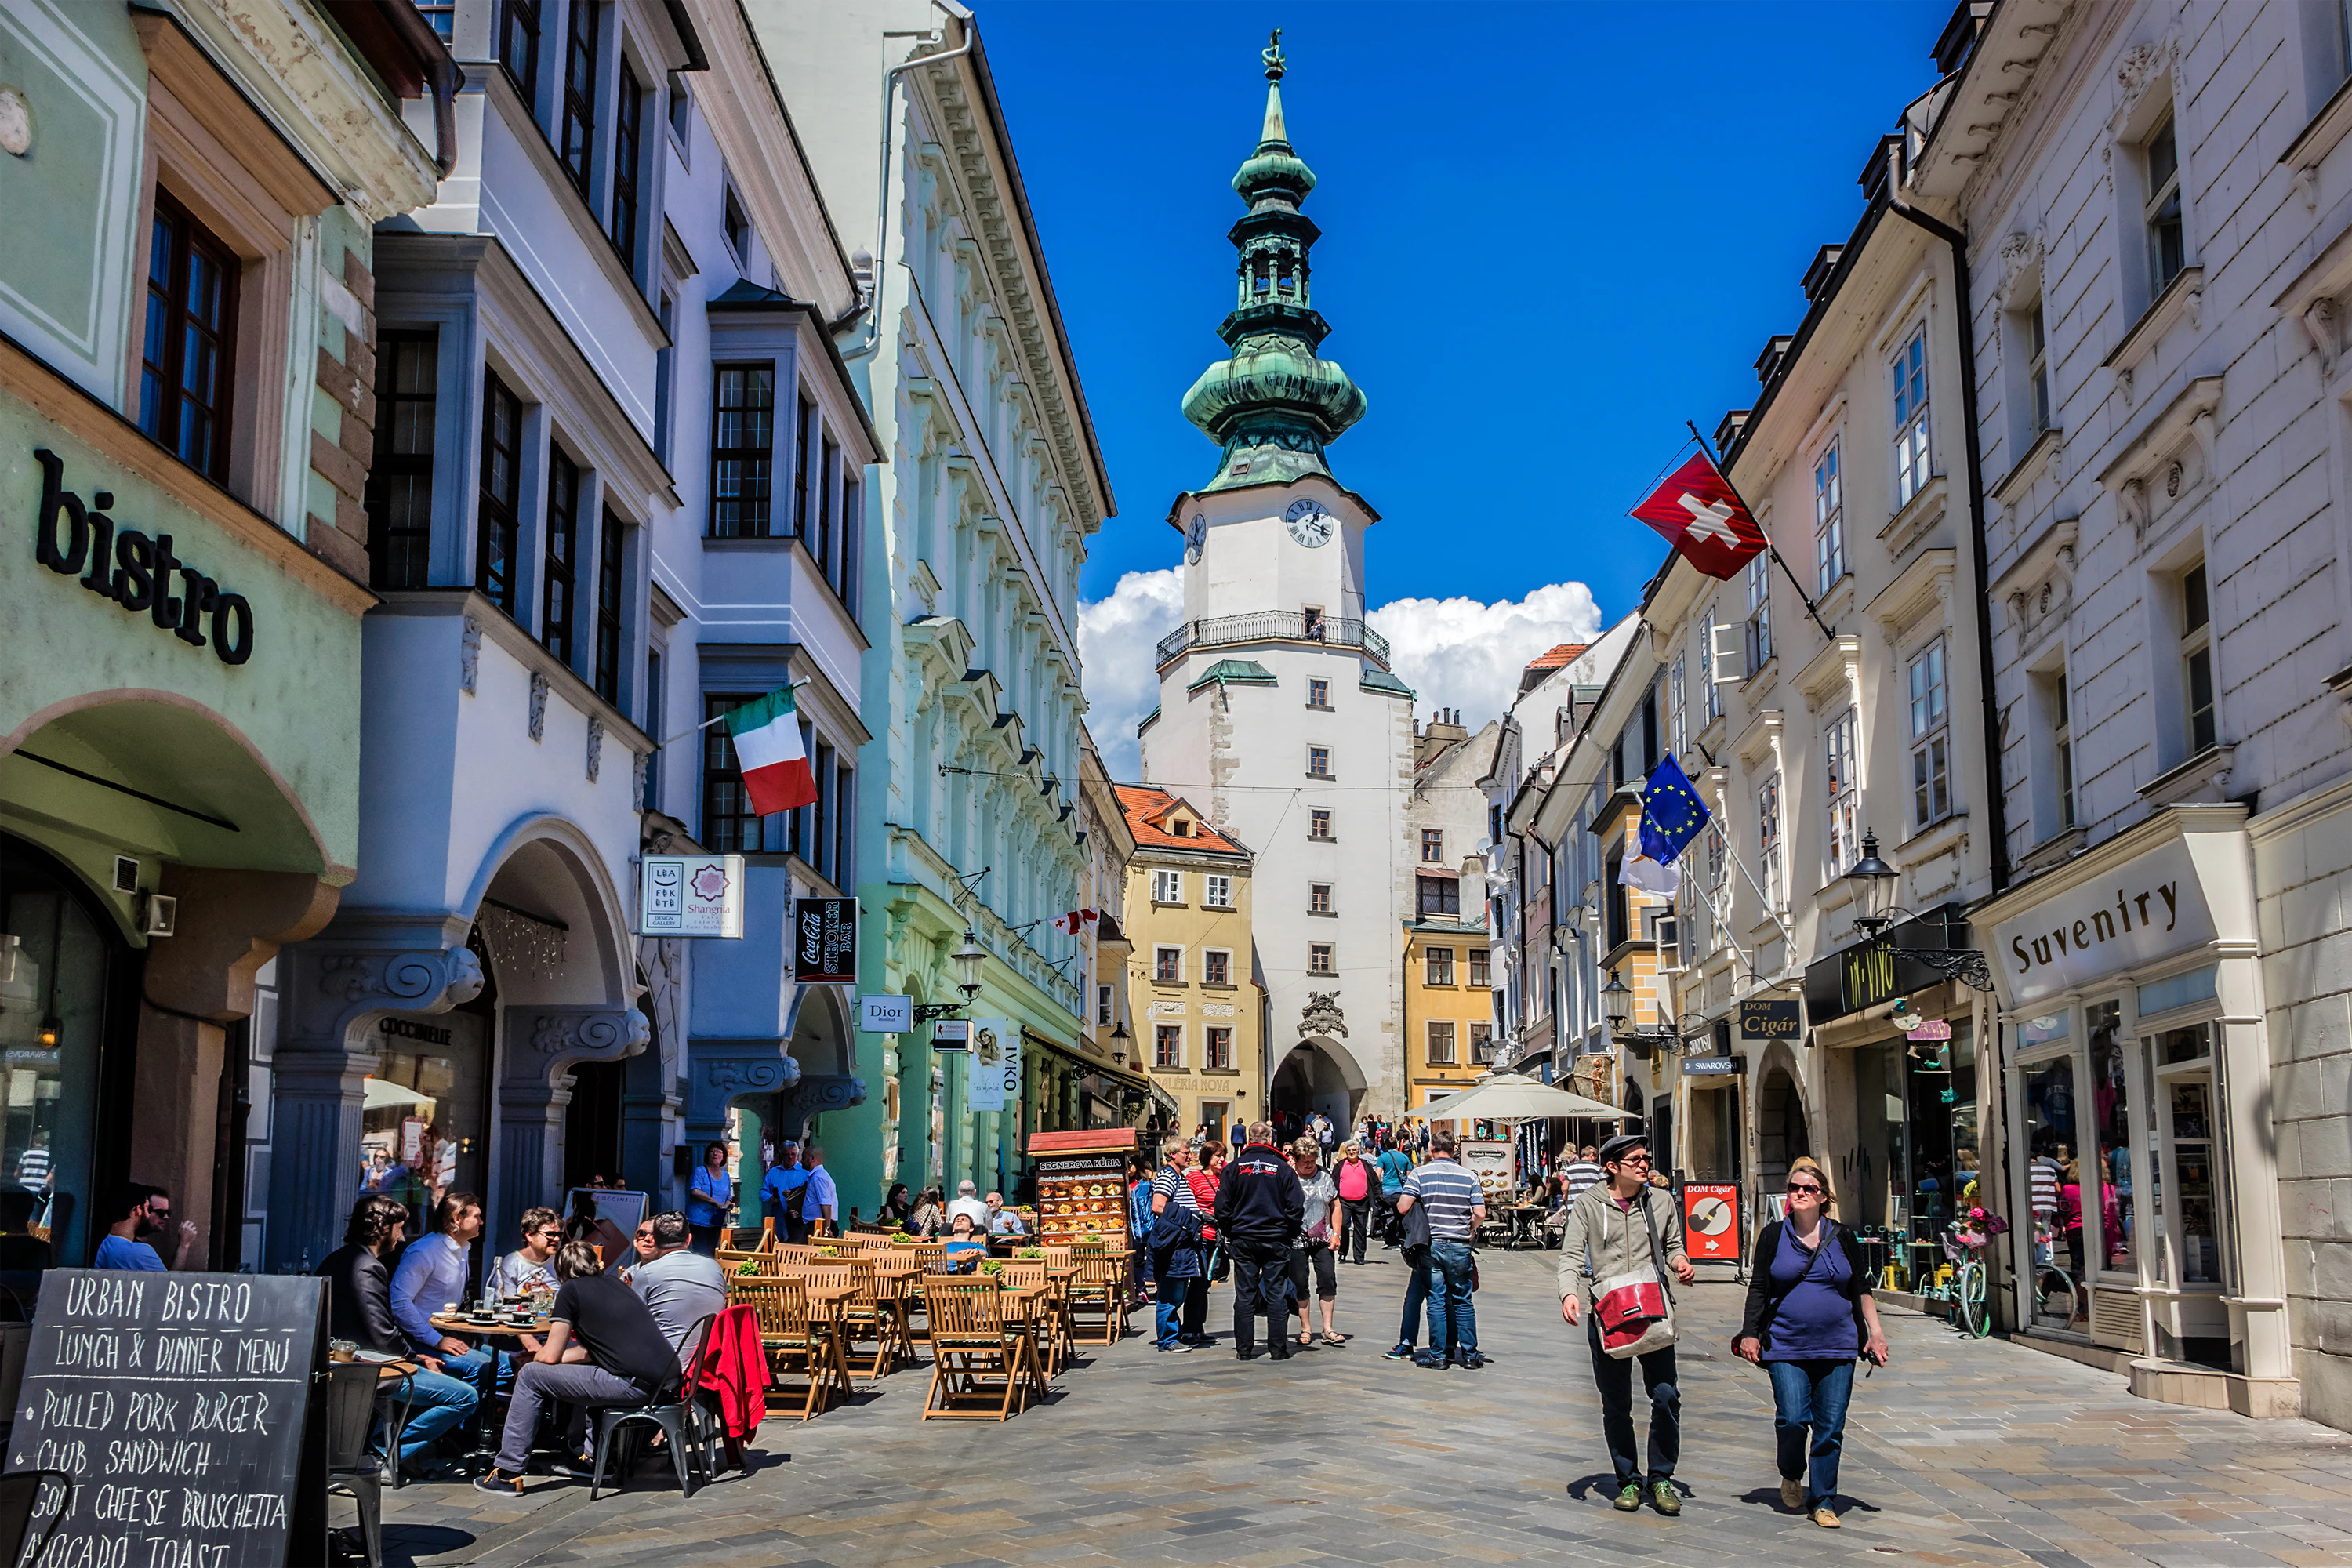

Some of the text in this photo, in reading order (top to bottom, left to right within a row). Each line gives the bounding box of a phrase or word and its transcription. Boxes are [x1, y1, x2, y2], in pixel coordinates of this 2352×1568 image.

[34, 448, 254, 665] bistro
[688, 904, 730, 915] Shangrila
[2012, 880, 2176, 974] Suveníry
[824, 901, 840, 974] STROKER
[840, 922, 852, 952] BAR
[869, 1005, 903, 1017] Dior
[1744, 1016, 1798, 1036] Cigár
[379, 1017, 451, 1045] COCCINELLE
[1004, 1047, 1017, 1091] IVKO
[1200, 1079, 1229, 1091] NOVA
[1040, 1157, 1121, 1171] SEGNEROVA KÚRIA
[67, 1277, 251, 1323] URBAN BISTRO
[56, 1330, 290, 1374] LUNCH & DINNER MENU
[41, 1388, 269, 1436] PULLED PORK BURGER
[37, 1439, 212, 1476] CLUB SANDWICH
[95, 1484, 171, 1526] CHEESE
[182, 1488, 288, 1530] BRUSCHETTA
[145, 1537, 230, 1568] TOAST
